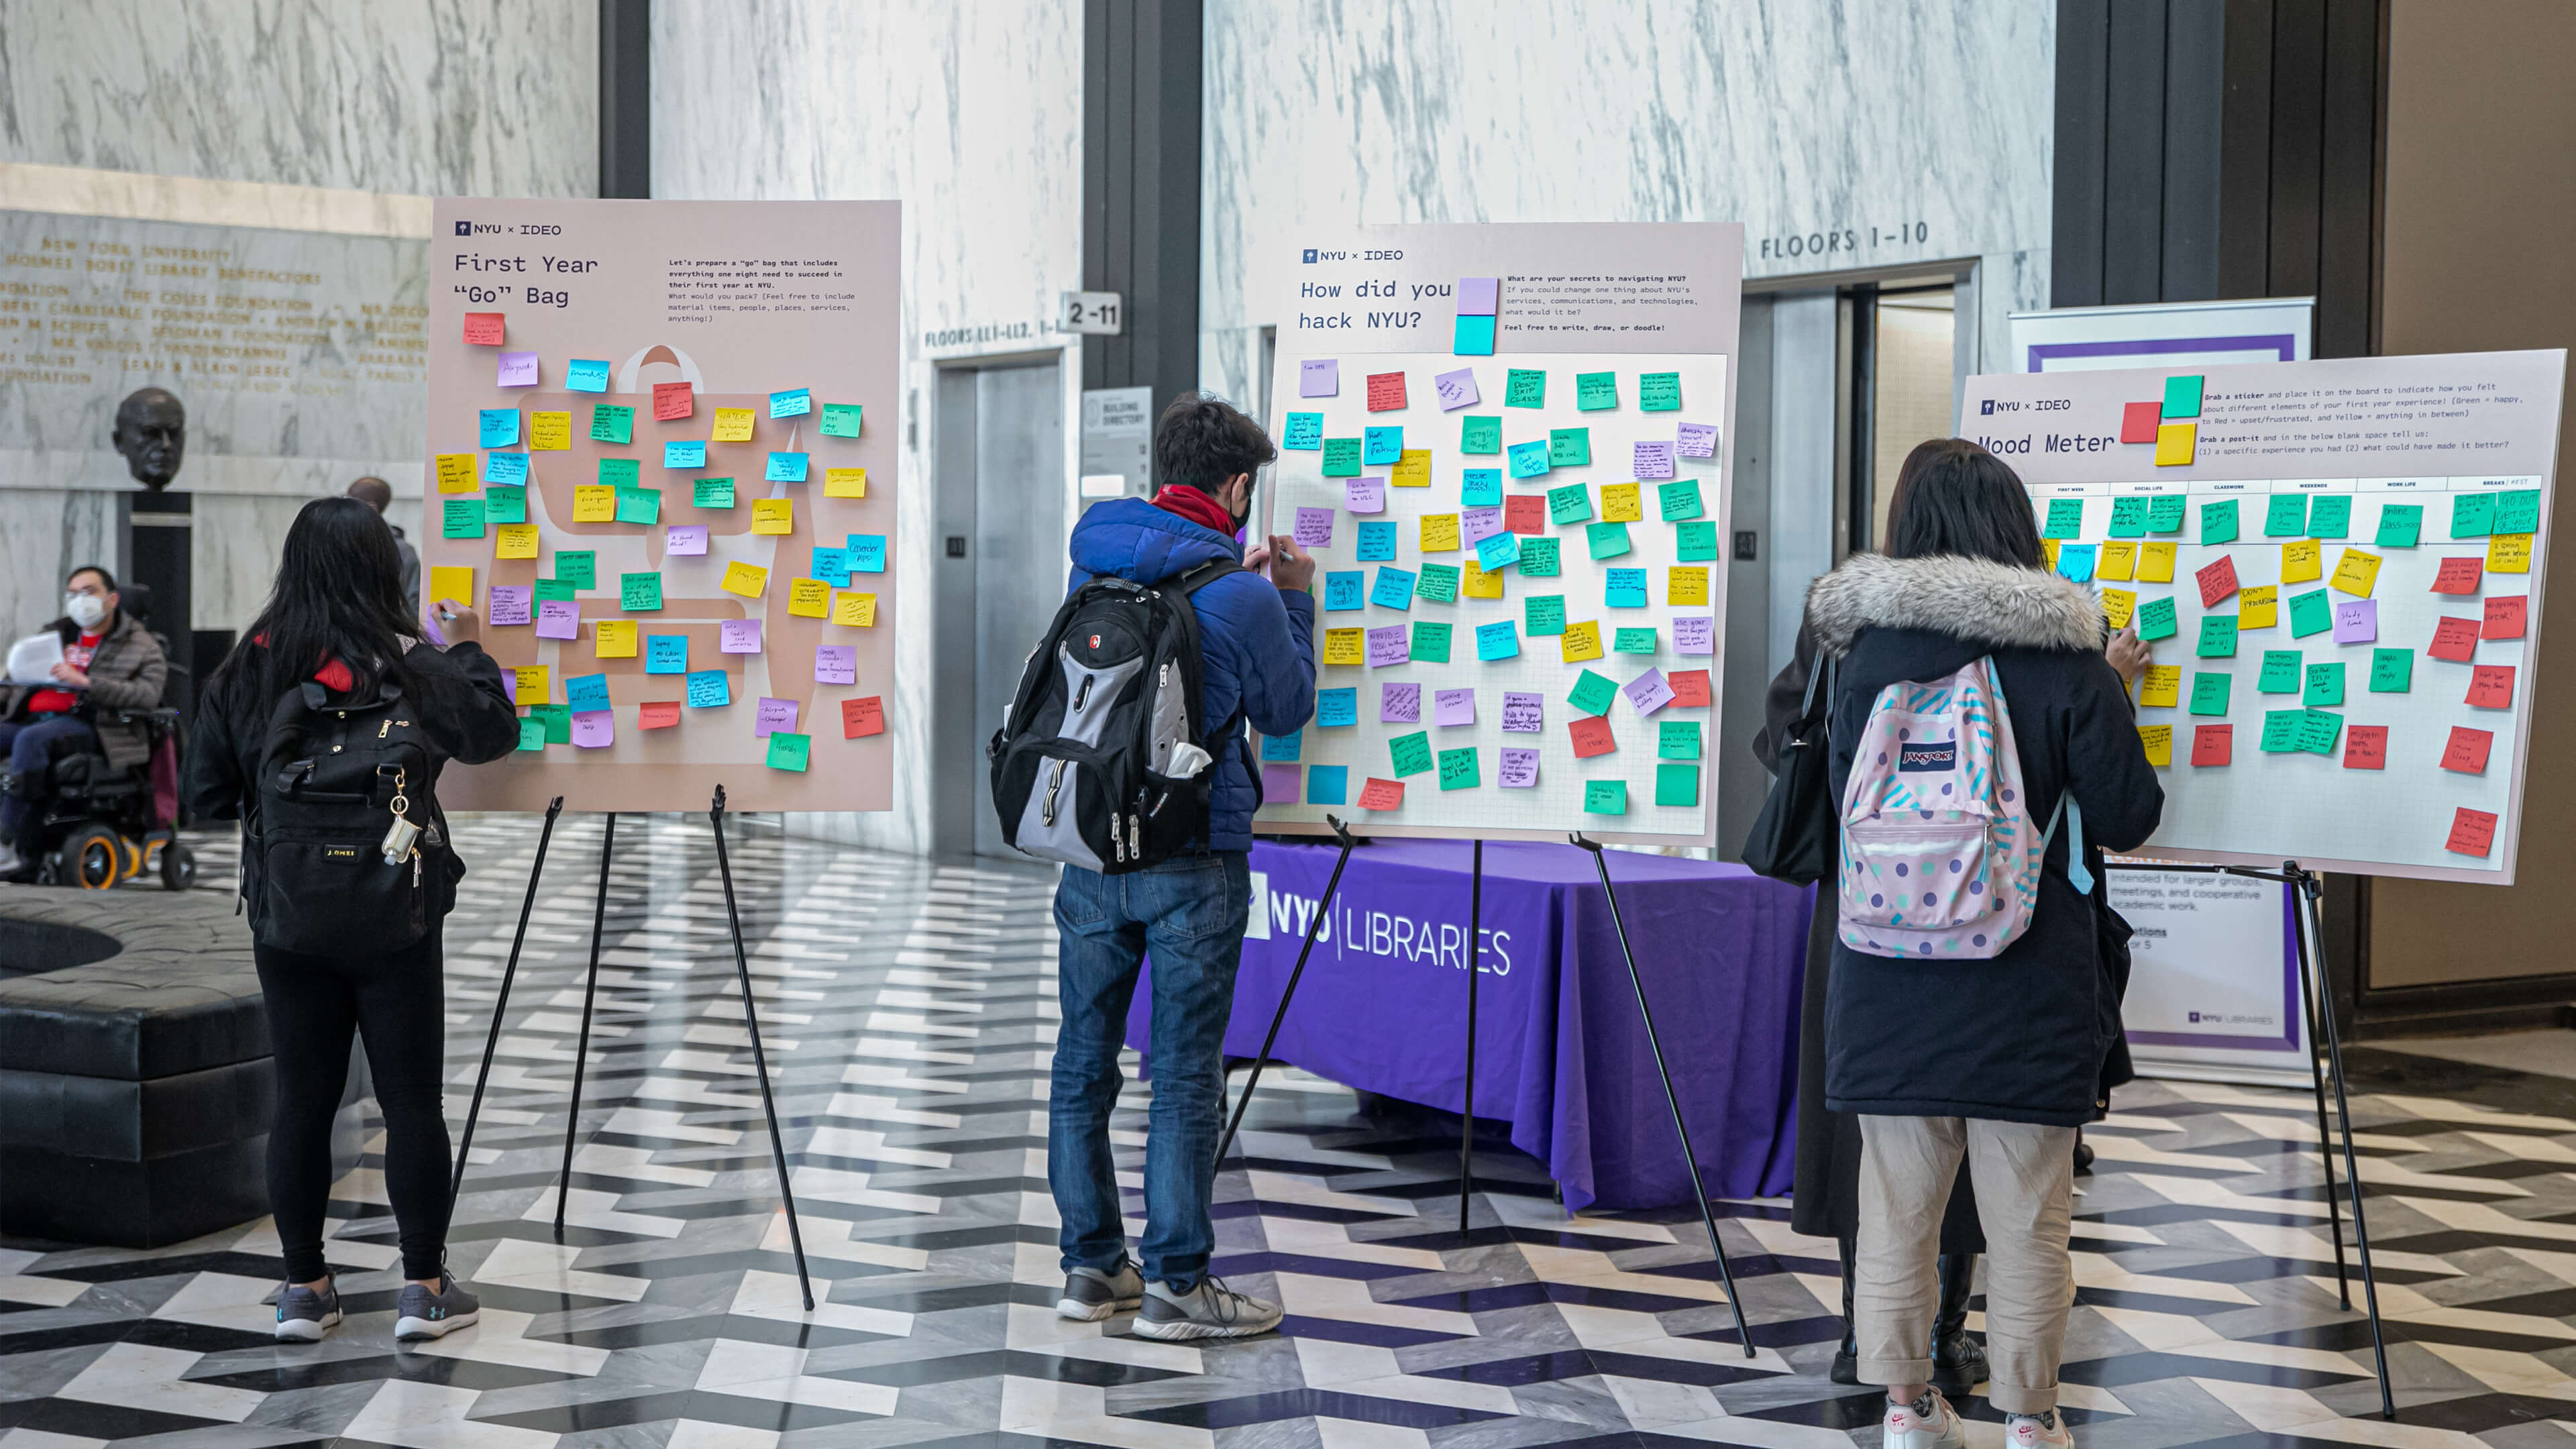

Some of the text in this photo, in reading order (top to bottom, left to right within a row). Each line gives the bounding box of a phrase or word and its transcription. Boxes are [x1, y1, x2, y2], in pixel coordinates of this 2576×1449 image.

[474, 224, 561, 235] NYU IDEO
[1762, 221, 1928, 260] FLOORS 1-10
[1320, 250, 1403, 260] NYU IDEO
[455, 252, 598, 273] First Year
[1618, 274, 1664, 282] navigating
[454, 285, 568, 308] “Go” Bag
[1301, 279, 1450, 301] How did you
[1640, 297, 1697, 305] technologies,
[1299, 311, 1421, 329] hack NYU?
[925, 327, 972, 347] FLOORS
[2234, 391, 2264, 400] sticker
[2285, 390, 2308, 398] place
[2355, 387, 2379, 395] board
[2397, 385, 2434, 394] indicate
[2477, 382, 2496, 390] felt
[1996, 399, 2071, 412] NYU IDEO
[1979, 433, 2114, 454] Mood Meter
[2229, 434, 2259, 443] post-it
[2310, 432, 2334, 440] below
[2198, 447, 2211, 455] (1)
[2223, 446, 2257, 455] specific
[2261, 445, 2306, 454] experience
[2345, 444, 2359, 452] (2)
[2475, 441, 2509, 449] better?
[2163, 875, 2216, 886] for larger
[2168, 889, 2190, 898] and
[2193, 890, 2261, 900] cooperative
[2112, 902, 2164, 910] academic
[1271, 890, 1510, 976] NYU LIBRARIES
